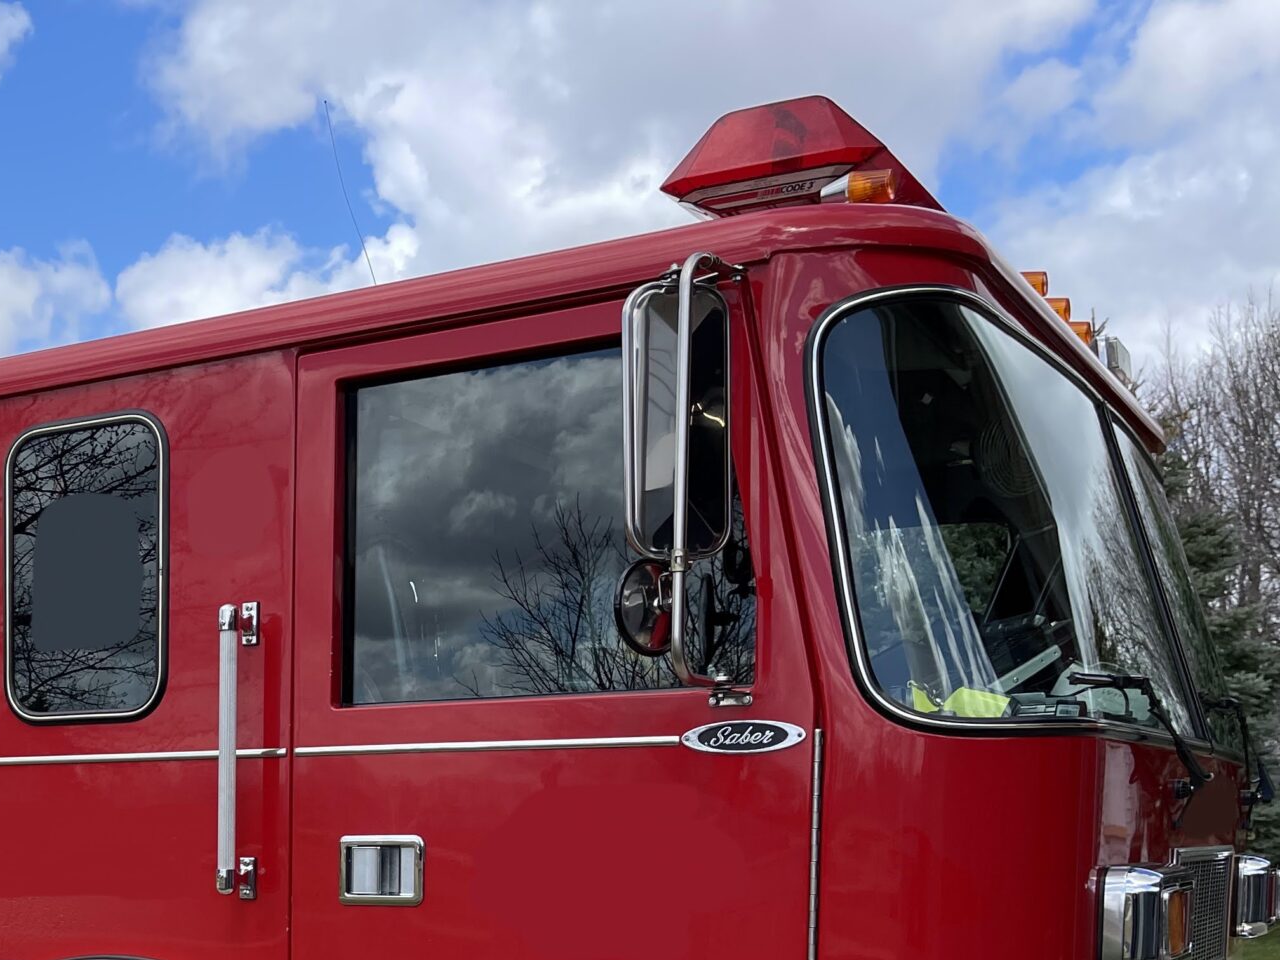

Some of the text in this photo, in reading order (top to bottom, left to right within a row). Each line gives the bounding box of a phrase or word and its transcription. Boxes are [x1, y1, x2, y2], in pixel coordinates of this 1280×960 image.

[780, 182, 807, 194] CODE
[807, 181, 815, 190] 3
[709, 725, 775, 747] Saber
